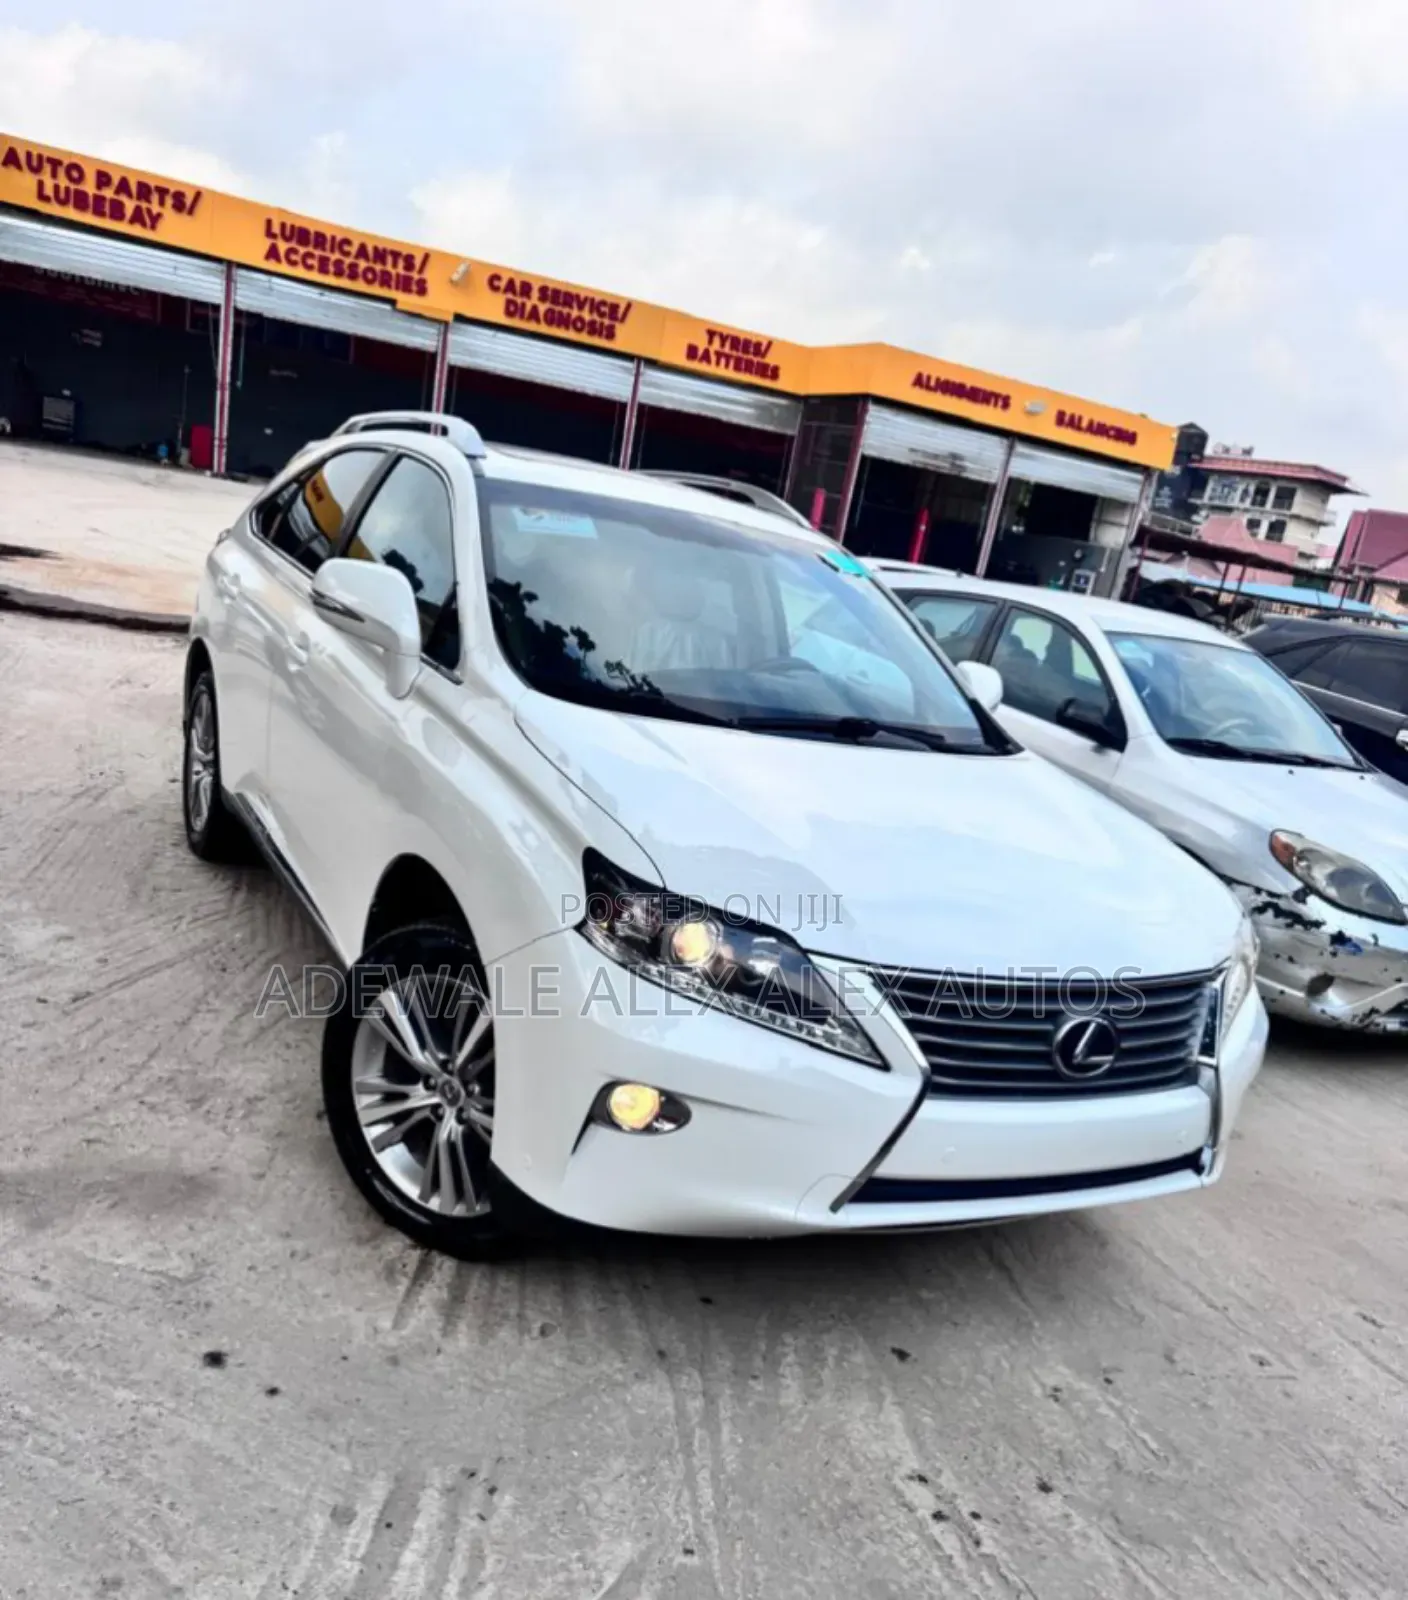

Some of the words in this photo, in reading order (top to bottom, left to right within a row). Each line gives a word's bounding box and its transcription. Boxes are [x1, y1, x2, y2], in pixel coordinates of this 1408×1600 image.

[1, 146, 85, 185] AUTO
[95, 169, 203, 216] PARTS/
[36, 179, 163, 231] LUBEBAY
[264, 217, 430, 275] LUBRICANTS/
[264, 242, 428, 297] ACCESSORIES
[487, 273, 533, 299] CAR
[537, 285, 632, 323] SERVICE/
[504, 298, 617, 341] DIAGNOSIS
[686, 343, 781, 381] BATTERIES
[705, 328, 773, 359] TYRES/
